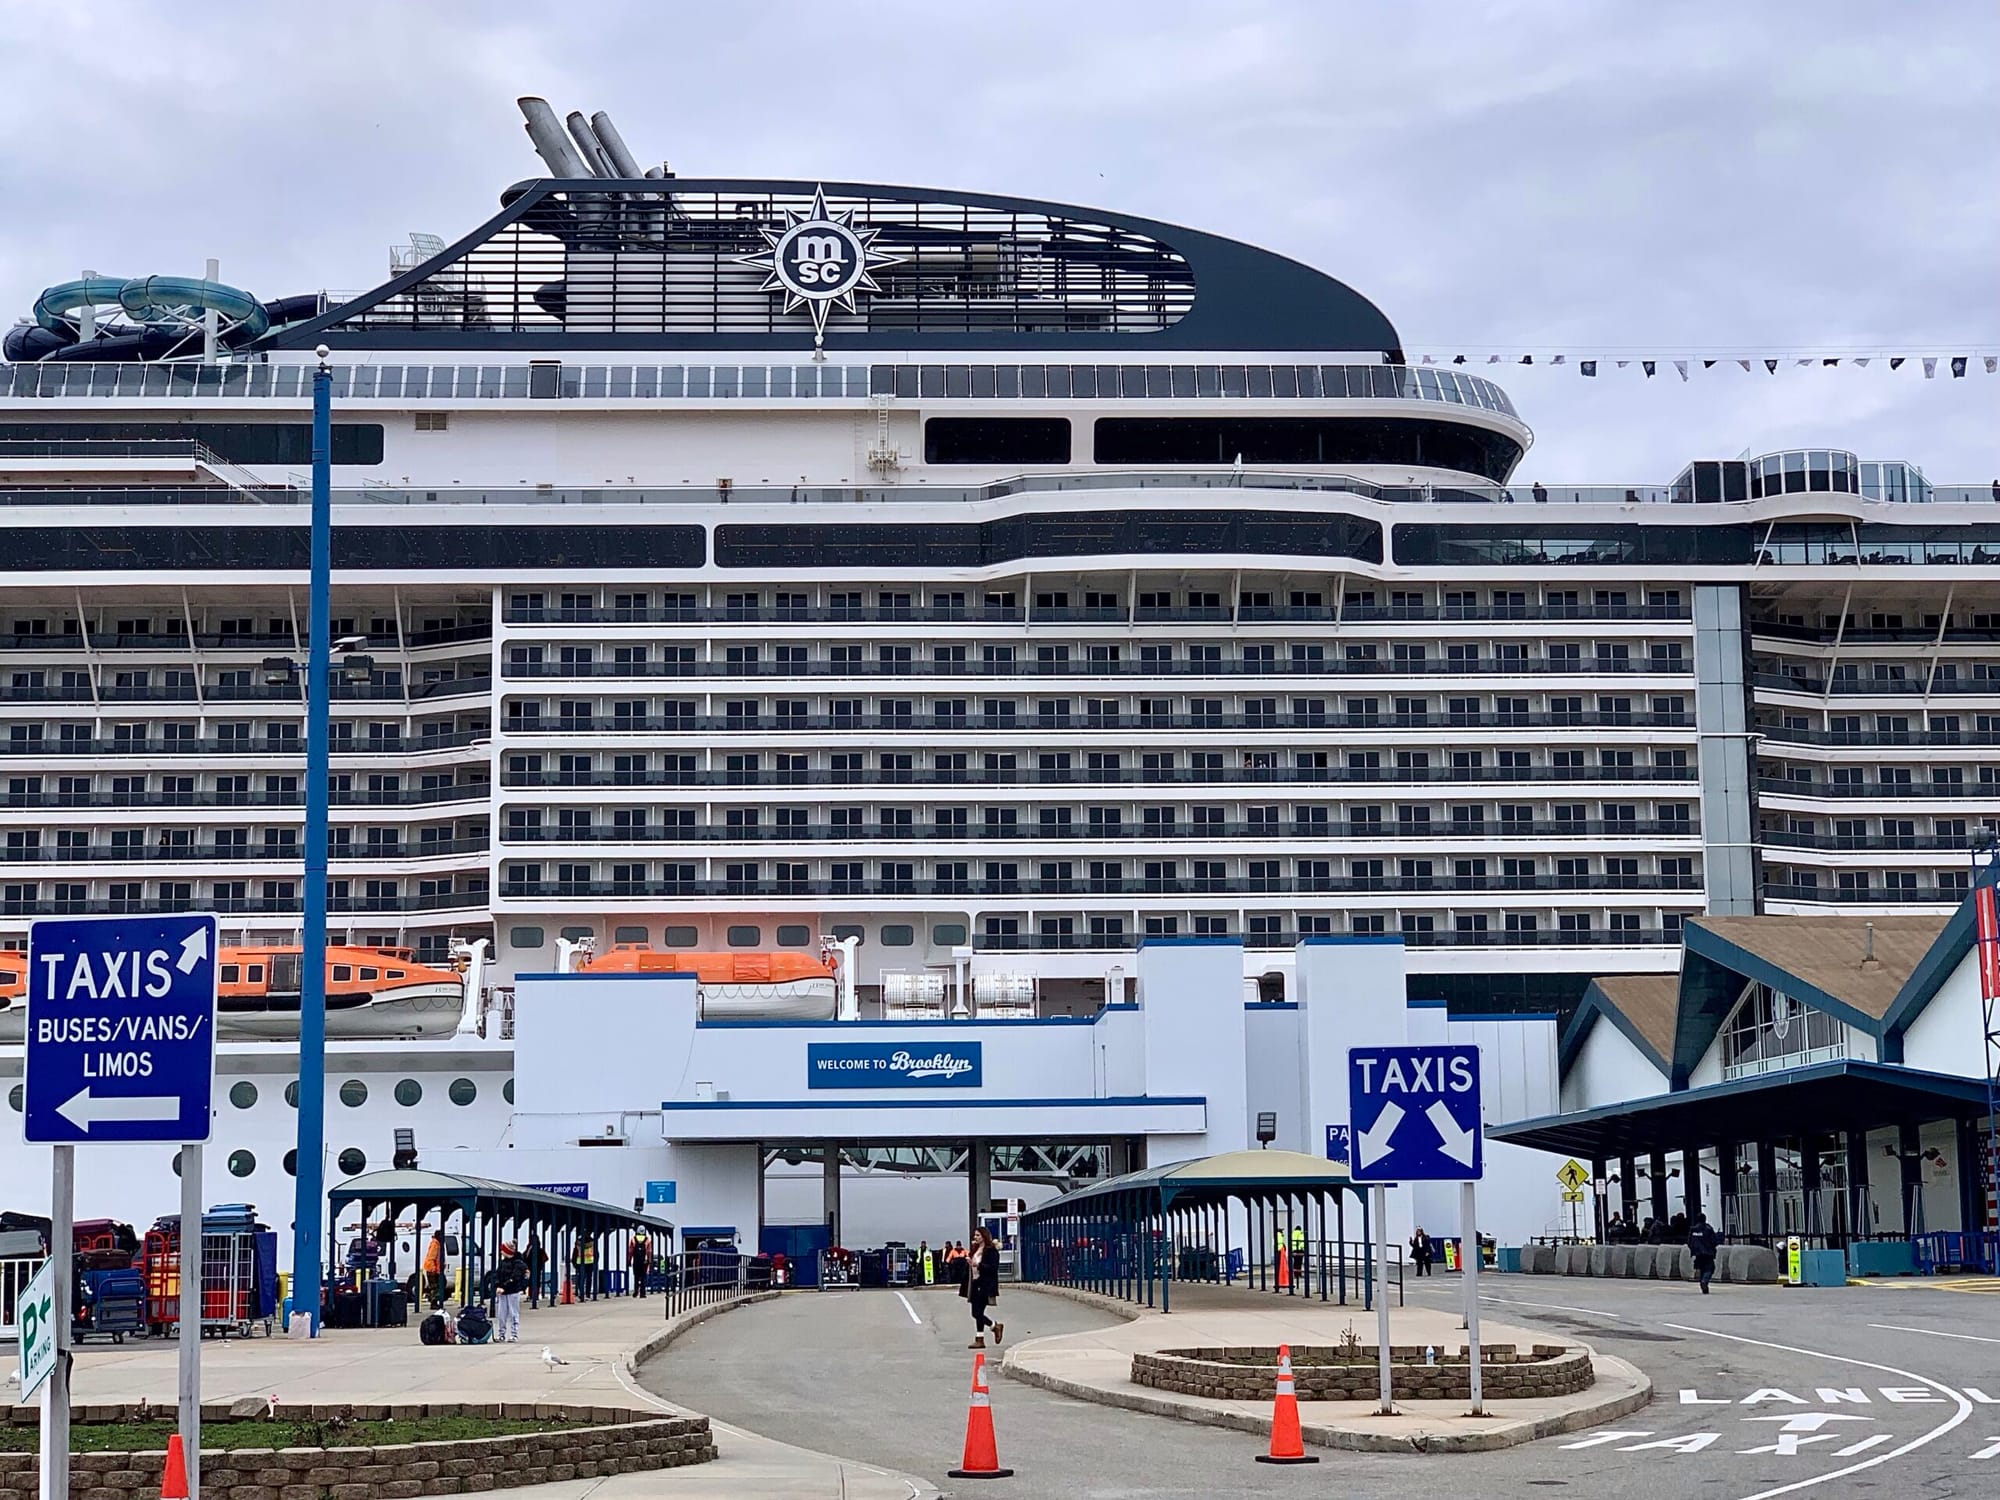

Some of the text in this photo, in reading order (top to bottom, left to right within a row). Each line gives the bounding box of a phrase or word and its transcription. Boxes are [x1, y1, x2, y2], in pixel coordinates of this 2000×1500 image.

[40, 949, 172, 1000] TAXIS
[38, 1014, 203, 1043] BUSES/VANS/
[83, 1051, 153, 1077] LIMOS
[817, 1050, 973, 1079] WELCOME TO Brooklyn
[1355, 1056, 1473, 1094] TAXIS
[1329, 1127, 1349, 1141] PA
[553, 1186, 571, 1194] DROP
[572, 1185, 585, 1193] OFF
[1678, 1387, 1947, 1405] LANE
[1558, 1430, 1894, 1457] TAXI
